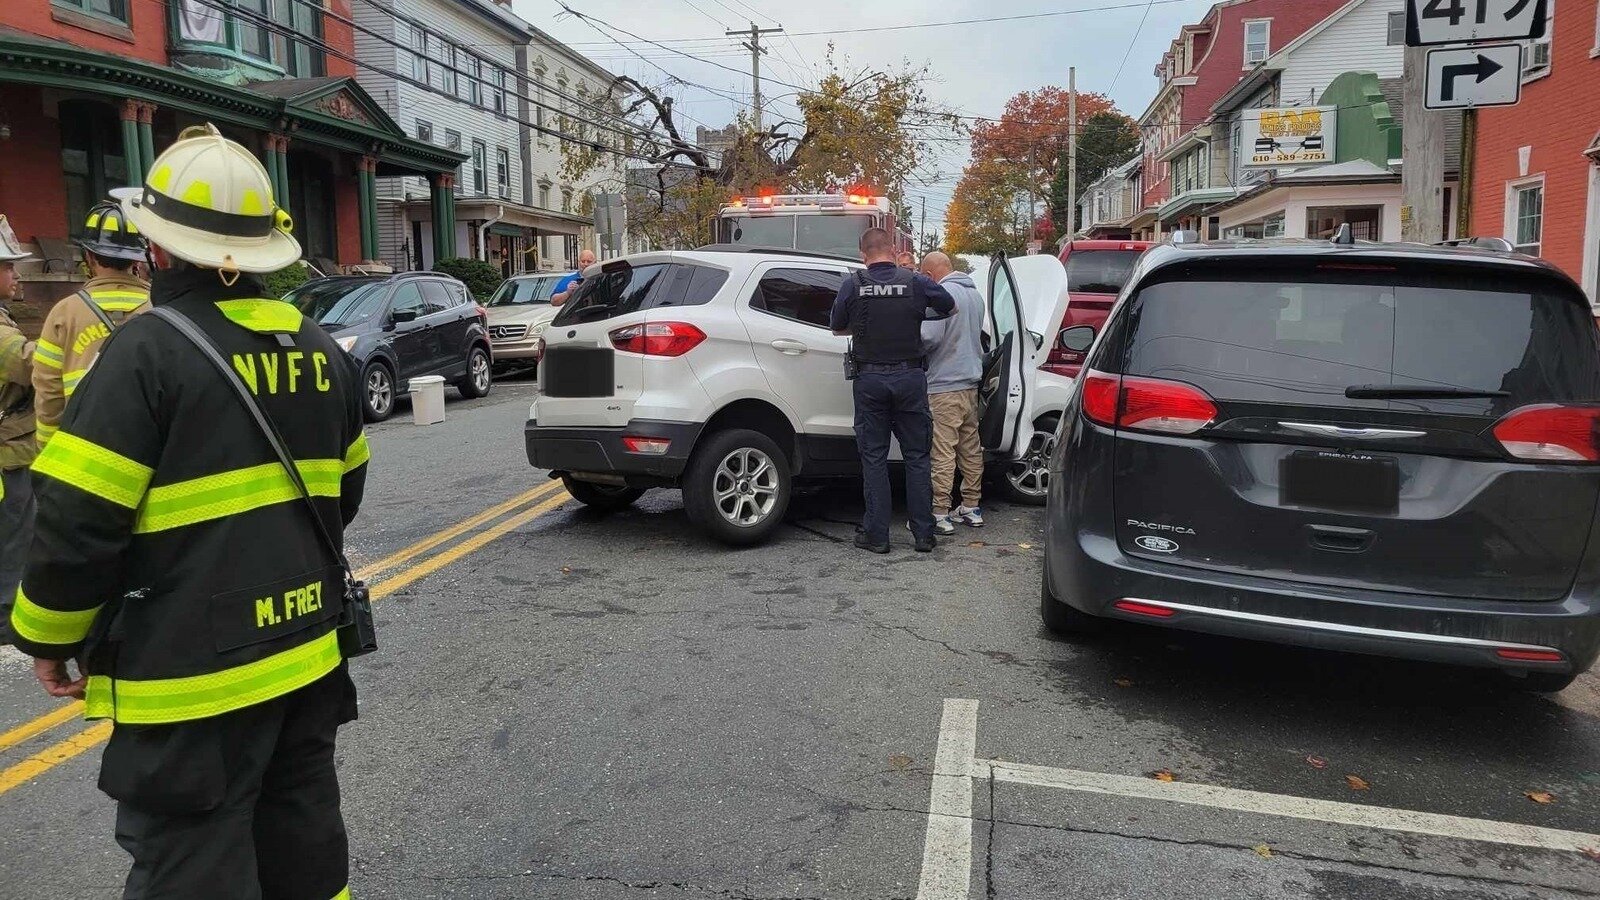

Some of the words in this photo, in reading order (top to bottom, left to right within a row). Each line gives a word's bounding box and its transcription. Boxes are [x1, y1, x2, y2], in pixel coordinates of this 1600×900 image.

[1260, 108, 1322, 124] BAR
[1252, 152, 1327, 163] 610-589-2751
[860, 284, 908, 296] EMT
[232, 351, 331, 396] NVFC
[1127, 519, 1196, 535] PACIFICA
[255, 596, 282, 628] M.
[284, 580, 323, 621] FREY
